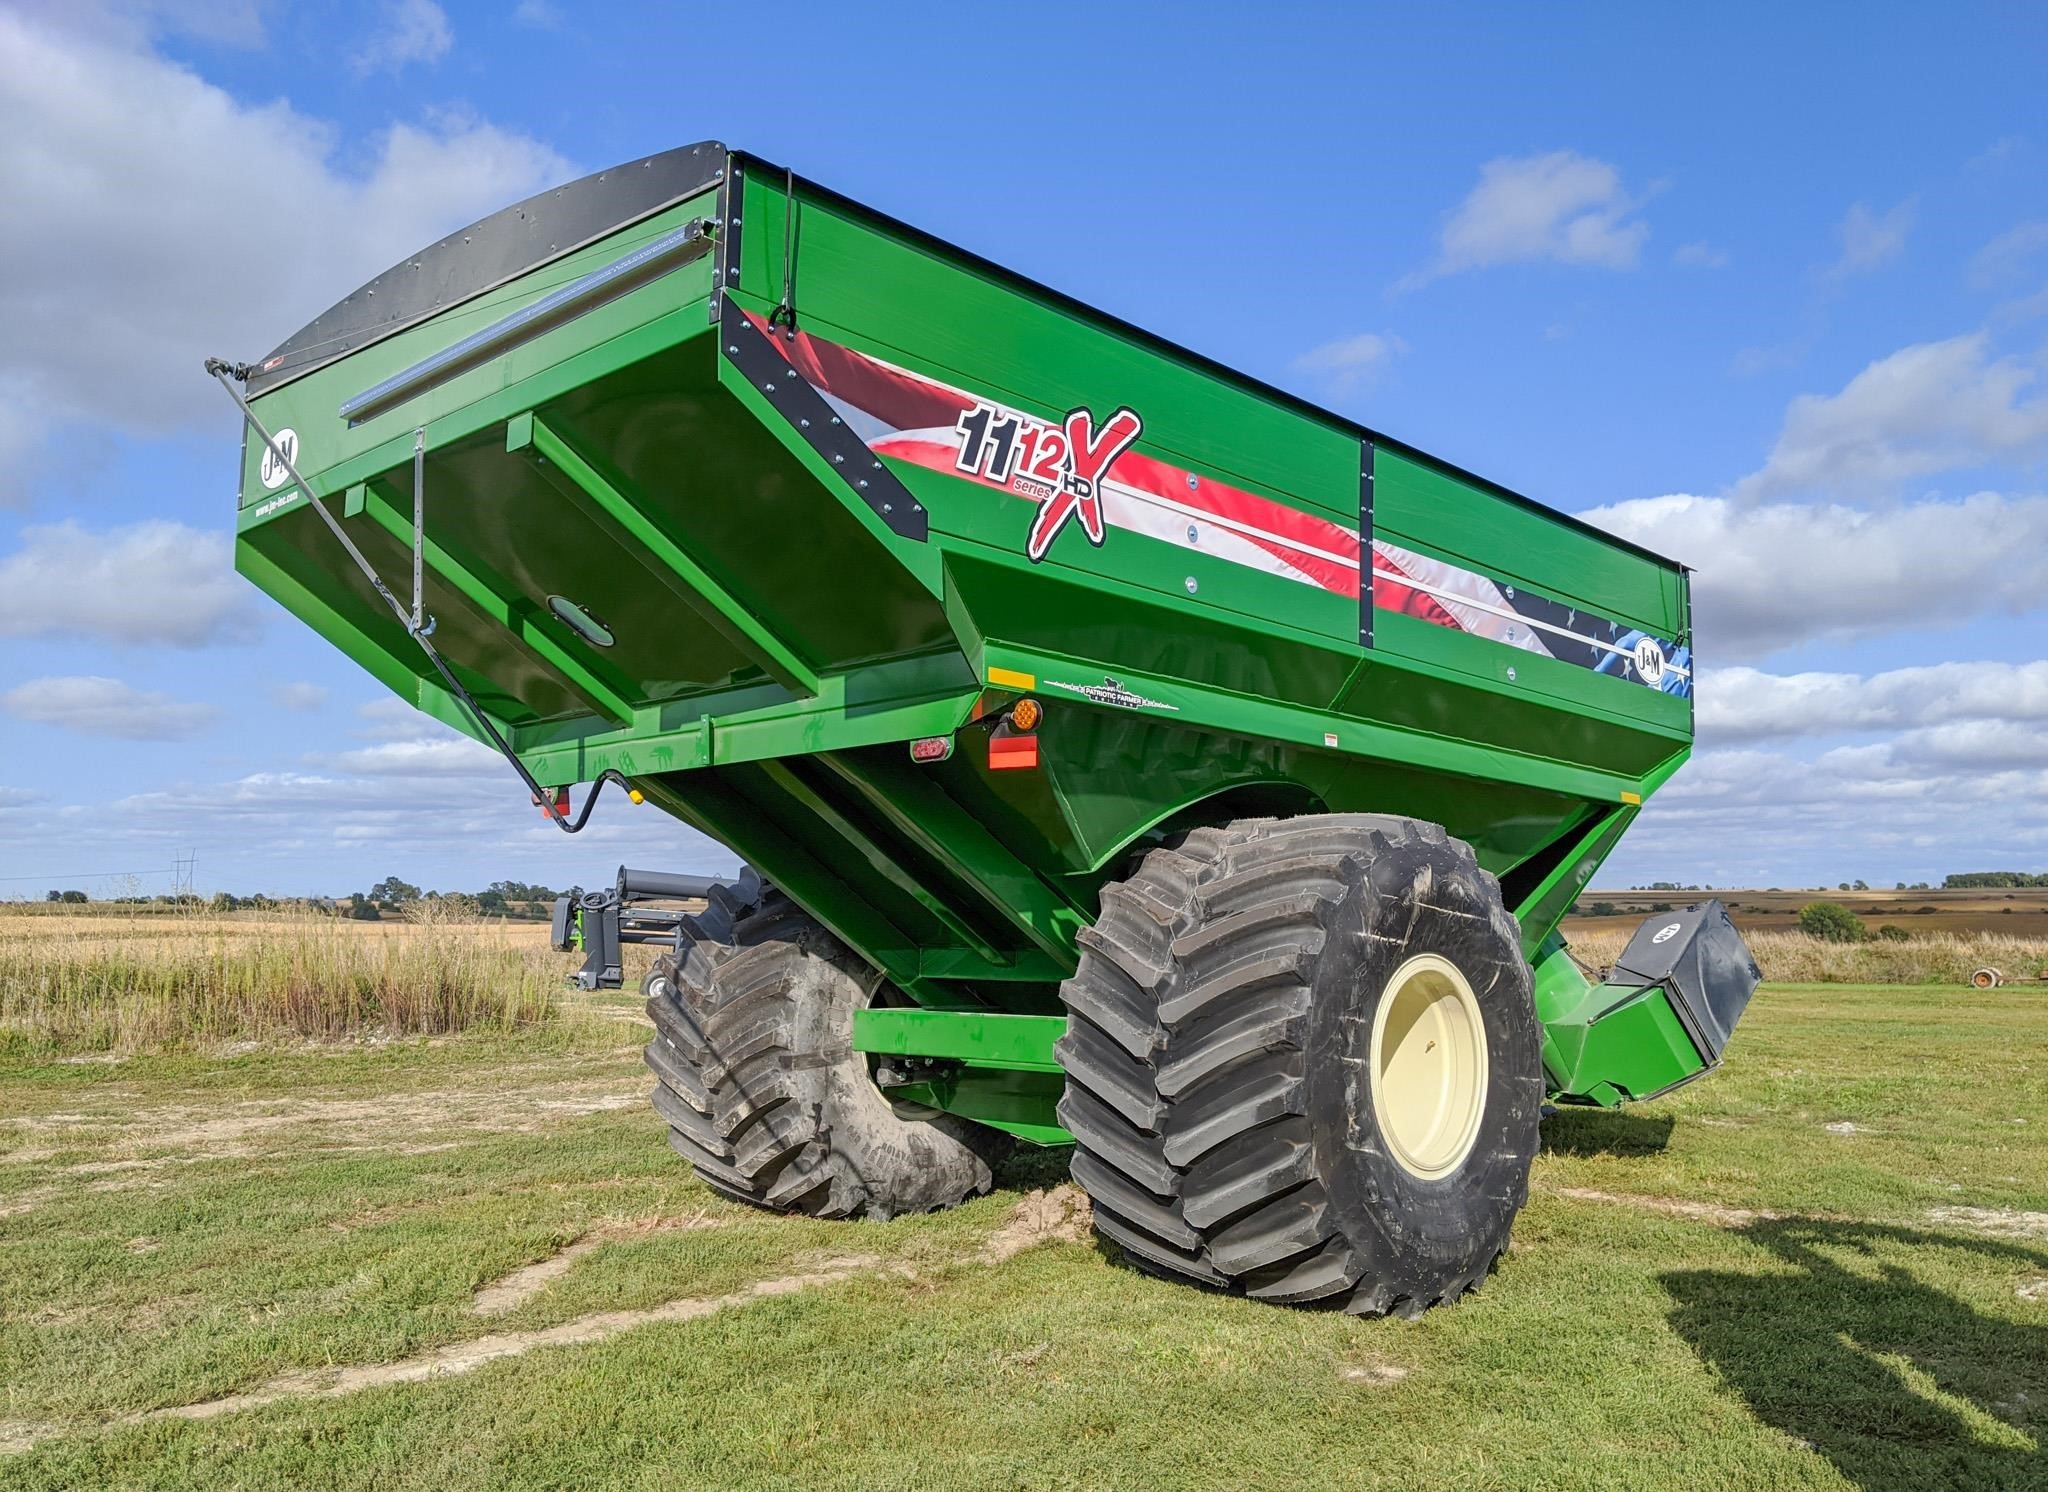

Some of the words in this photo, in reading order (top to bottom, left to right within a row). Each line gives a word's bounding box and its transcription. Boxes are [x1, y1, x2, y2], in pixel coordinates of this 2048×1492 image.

[1014, 477, 1050, 499] series
[1063, 472, 1093, 498] HD
[1637, 646, 1660, 675] J&M
[1085, 687, 1117, 701] PATRIOTIC
[1117, 694, 1142, 705] FARMER
